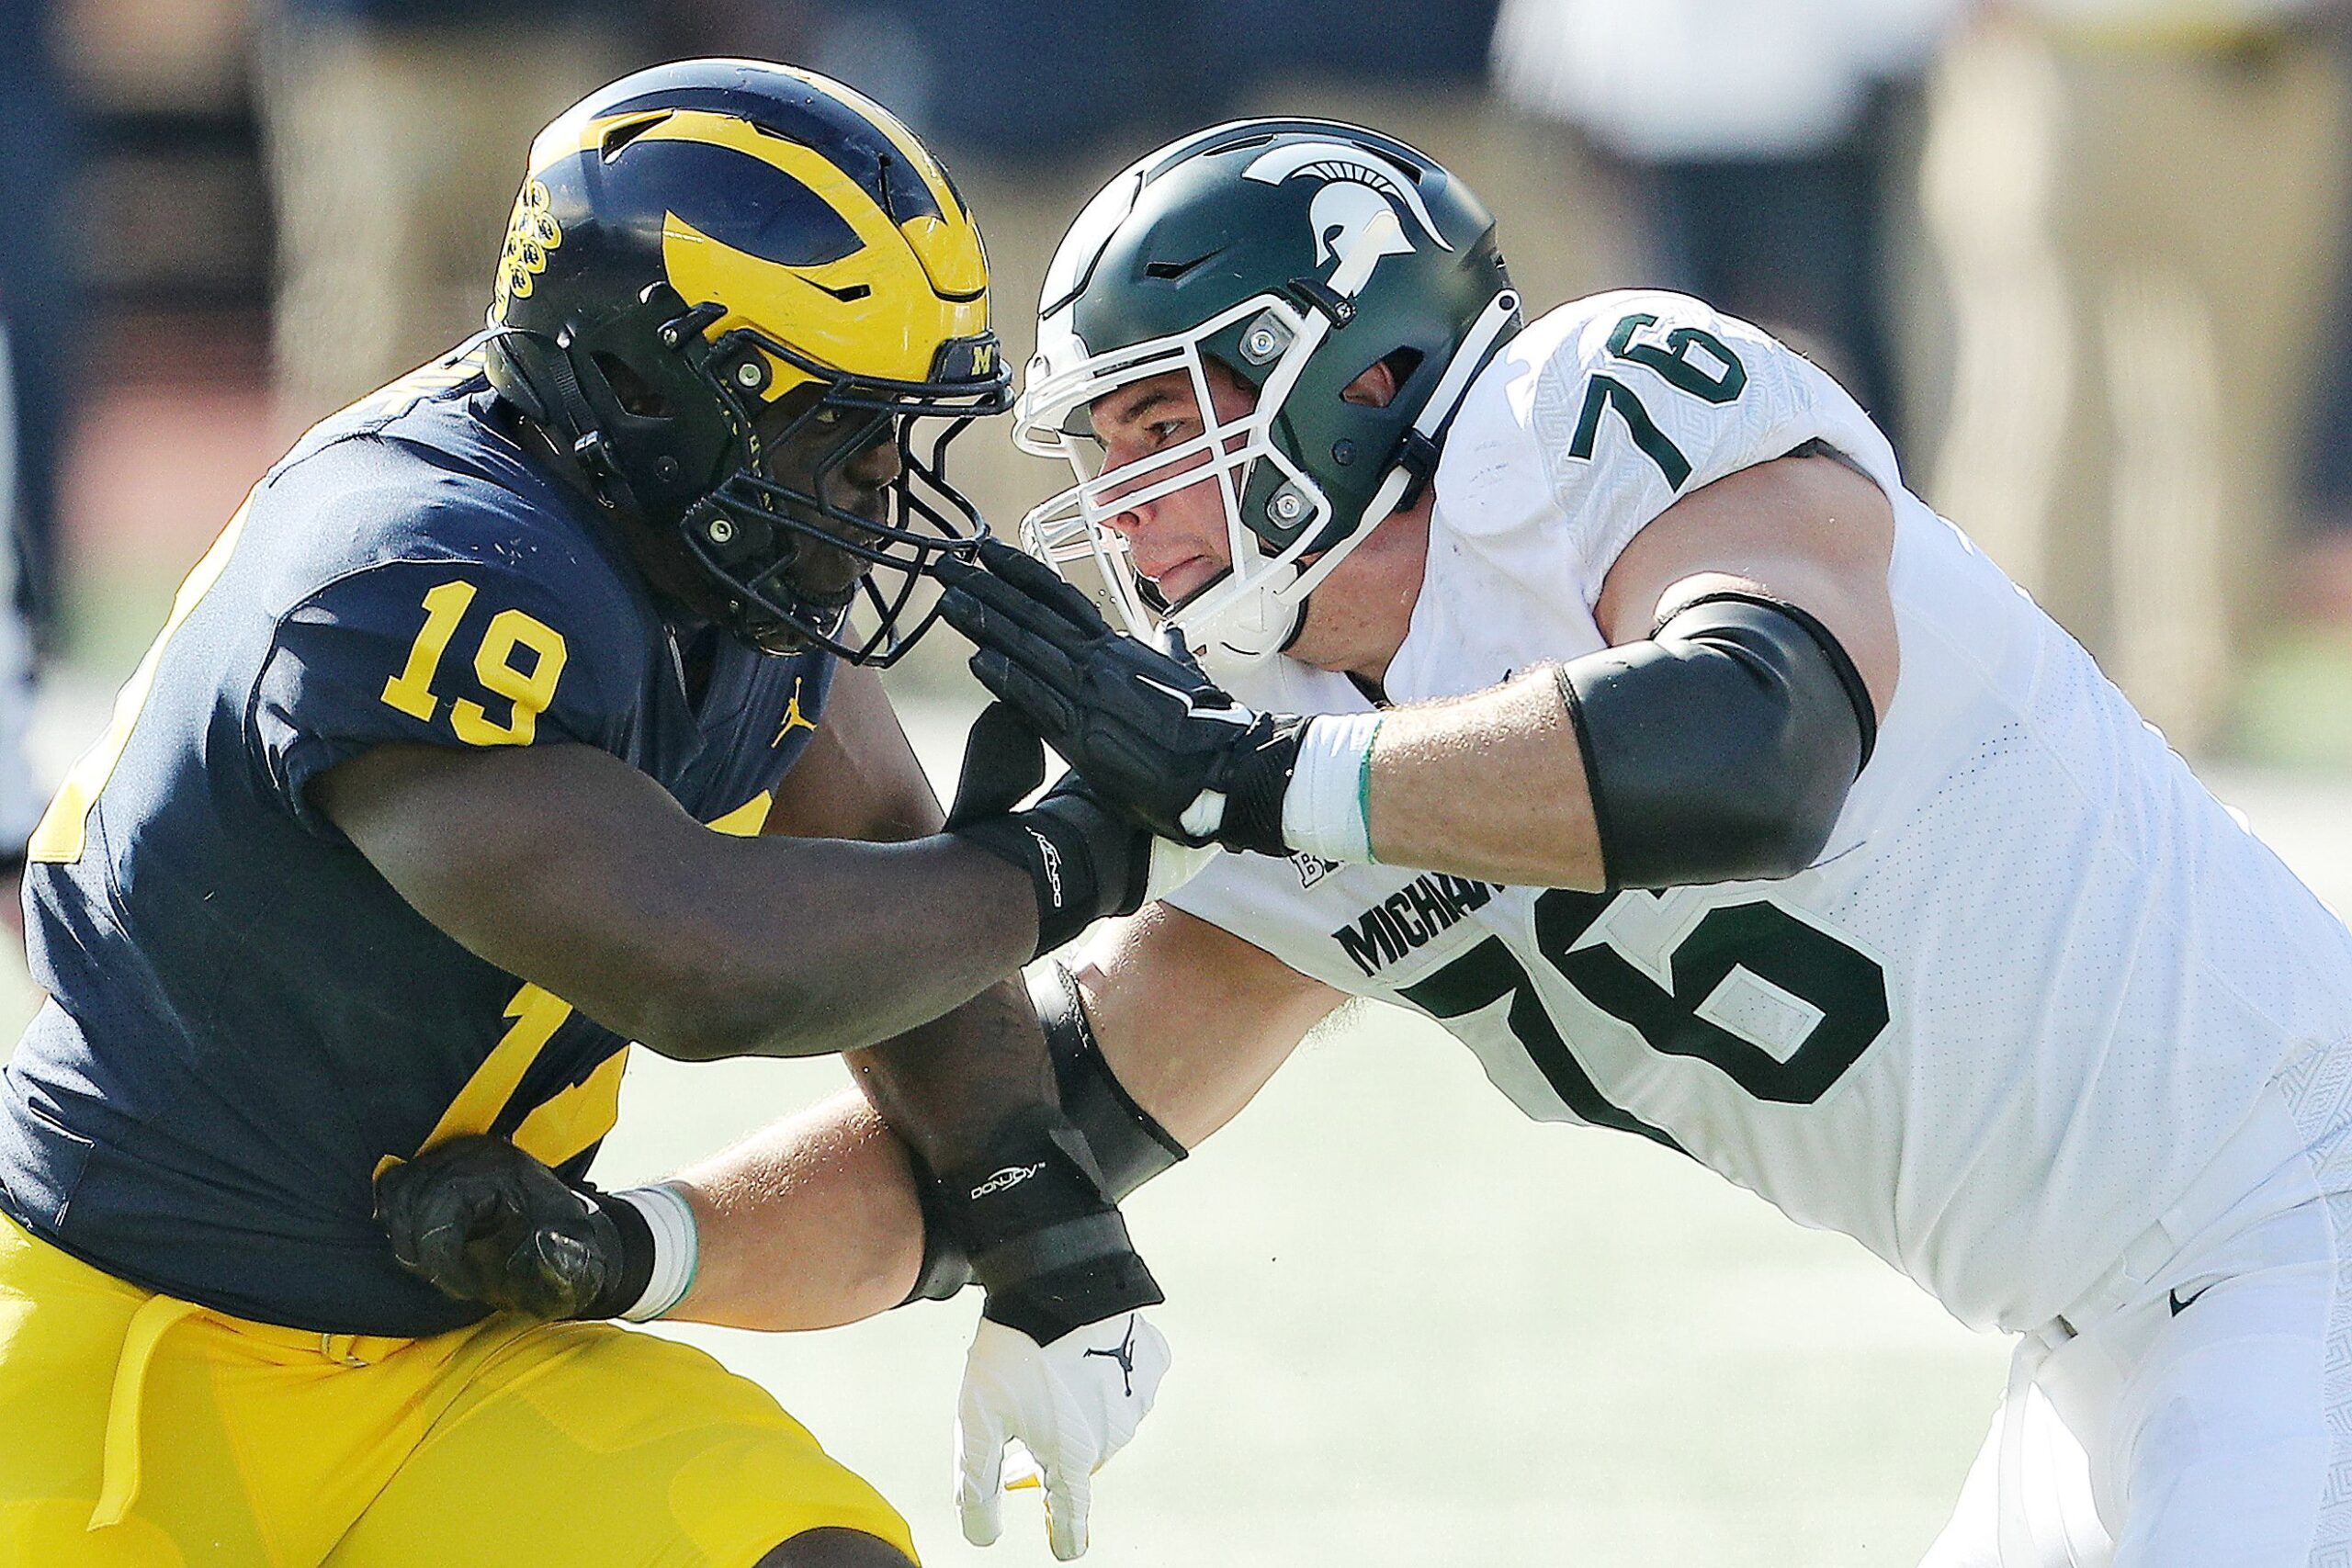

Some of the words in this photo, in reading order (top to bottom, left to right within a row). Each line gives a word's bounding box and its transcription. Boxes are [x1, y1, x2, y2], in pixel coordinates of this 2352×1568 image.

[971, 344, 992, 376] M
[1568, 312, 1747, 493] 76
[380, 580, 568, 747] 19
[1394, 888, 1891, 1165] 76
